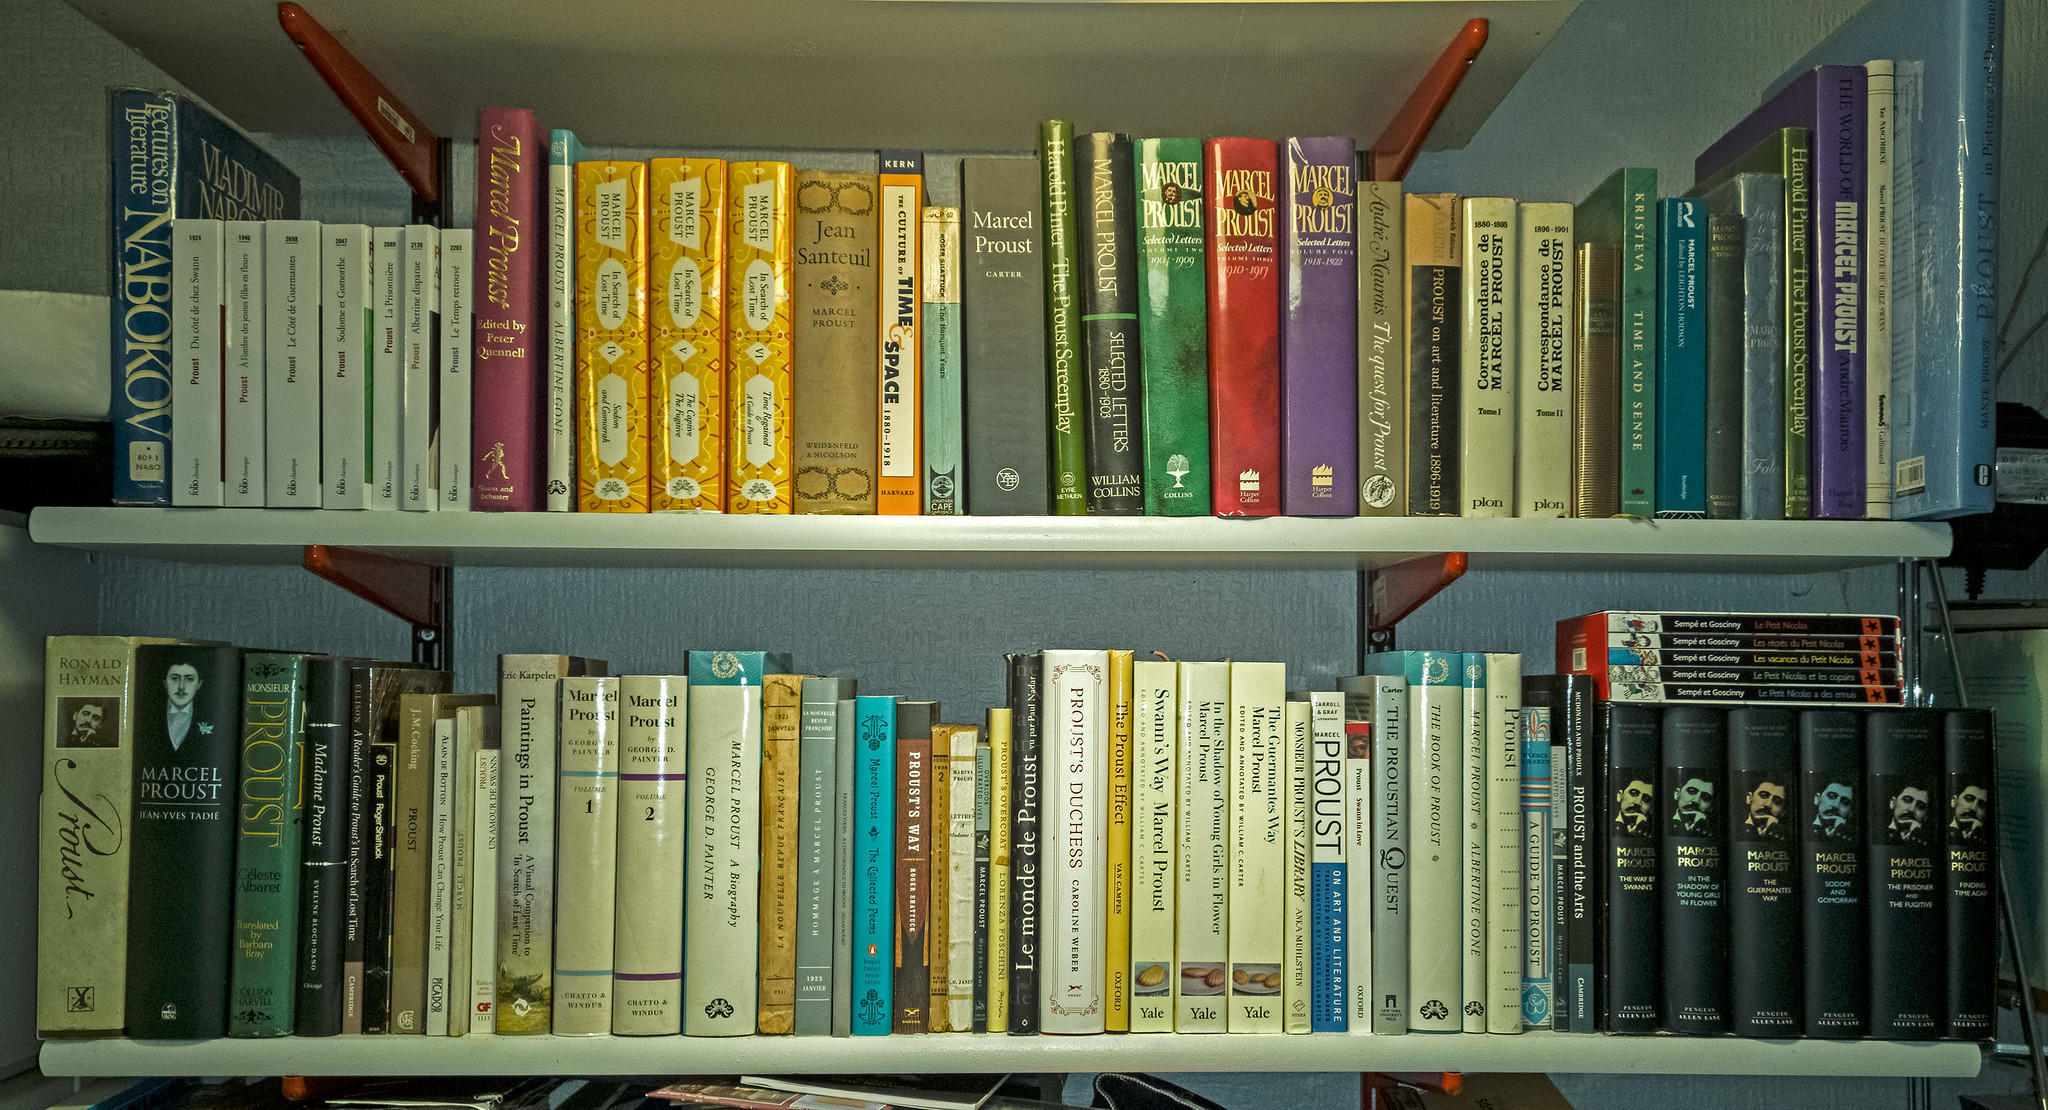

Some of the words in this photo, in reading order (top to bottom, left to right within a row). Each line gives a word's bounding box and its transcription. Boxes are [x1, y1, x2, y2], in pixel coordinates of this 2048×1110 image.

[125, 107, 148, 195] Literature
[145, 103, 171, 176] Lectures
[489, 125, 521, 225] Marcel
[884, 160, 915, 168] KERN
[1046, 138, 1067, 197] Harold
[1140, 161, 1202, 194] MARCEL
[1293, 164, 1354, 197] MARCEL
[152, 179, 169, 206] on
[1092, 159, 1115, 229] MARCEL
[1215, 169, 1275, 202] MARCEL
[600, 193, 610, 240] PROUST
[611, 193, 621, 240] MARCEL
[972, 210, 1033, 230] Marcel
[1049, 198, 1067, 248] Pinter
[1141, 198, 1203, 229] PROUST
[1215, 206, 1276, 238] PROUST
[1292, 203, 1354, 235] PROUST
[814, 219, 856, 244] Jean
[898, 210, 907, 264] CULTURE
[975, 235, 1033, 255] Proust
[1477, 234, 1490, 253] de
[1632, 192, 1645, 273] KRISTEVA
[1833, 201, 1859, 278] MARCEL
[190, 256, 200, 282] Swann
[487, 225, 521, 311] Proust
[797, 247, 871, 269] Santeuil
[898, 265, 904, 275] OF
[1096, 231, 1118, 297] PROUST
[1491, 233, 1504, 307] PROUST
[336, 256, 346, 298] Gomorrhe
[600, 274, 610, 291] Lost
[611, 270, 621, 281] In
[1051, 257, 1071, 297] The
[190, 284, 200, 304] chez
[337, 299, 346, 309] et
[600, 293, 610, 316] Time
[611, 282, 621, 308] Search
[898, 276, 913, 327] TIME
[1432, 268, 1445, 323] PROUST
[124, 206, 173, 441] NABOKOV
[190, 306, 200, 318] de
[190, 319, 200, 336] côté
[336, 311, 346, 343] Sodome
[611, 309, 621, 319] of
[1052, 299, 1072, 348] Proust
[1477, 260, 1491, 390] Correspondance
[1833, 281, 1858, 354] PROUST
[190, 338, 200, 349] Du
[1373, 319, 1393, 351] The
[1431, 327, 1441, 342] on
[1632, 310, 1644, 352] TIME
[336, 351, 346, 377] Proust
[1108, 331, 1127, 392] SELECTED
[1431, 345, 1442, 363] art
[1491, 312, 1504, 391] MARCEL
[190, 358, 200, 385] Proust
[884, 340, 899, 405] SPACE
[1367, 351, 1390, 396] quest
[1431, 367, 1442, 388] and
[1632, 360, 1643, 393] AND
[1054, 348, 1075, 435] Screenplay
[1111, 397, 1129, 453] LETTERS
[1366, 397, 1391, 420] for
[1431, 393, 1442, 449] literature
[1366, 413, 1393, 472] Proust
[1631, 402, 1643, 451] SENSE
[1092, 474, 1140, 486] WILLIAM
[1093, 486, 1141, 498] COLLINS
[1428, 453, 1442, 511] 1896-1919
[1472, 497, 1503, 510] plon
[59, 656, 122, 671] RONALD
[1673, 654, 1699, 664] Sempé
[1707, 654, 1741, 664] Goscinny
[1800, 656, 1810, 664] du
[1810, 655, 1828, 664] Petit
[1828, 656, 1855, 665] Nicolas
[59, 672, 123, 687] HAYMAN
[1068, 687, 1085, 773] PROUST'S
[1112, 701, 1128, 729] The
[1151, 688, 1170, 756] Swann's
[1385, 706, 1400, 740] THE
[1430, 704, 1442, 730] THE
[514, 697, 536, 769] Paintings
[1293, 721, 1305, 773] MONSIEUR
[1503, 708, 1520, 770] Proust
[729, 740, 741, 795] MARCEL
[1112, 733, 1128, 780] Proust
[1430, 733, 1442, 772] BOOK
[140, 765, 222, 782] MARCEL
[240, 696, 290, 848] PROUST
[311, 742, 328, 802] Madame
[519, 775, 533, 789] in
[907, 751, 921, 819] PROUST'S
[1149, 758, 1169, 793] Way
[1430, 775, 1442, 790] OF
[140, 783, 222, 801] PROUST
[1016, 754, 1038, 824] Proust
[1112, 783, 1128, 825] Effect
[1314, 740, 1342, 856] PROUST
[1385, 746, 1400, 841] PROUSTIAN
[436, 813, 448, 834] How
[517, 795, 534, 844] Proust
[728, 797, 741, 849] PROUST
[1293, 776, 1306, 838] PROUST'S
[1430, 792, 1442, 847] PROUST
[1573, 786, 1585, 841] PROUST
[311, 804, 328, 847] Proust
[907, 823, 921, 853] WAY
[1068, 782, 1085, 869] DUCHESS
[1151, 801, 1168, 854] Marcel
[1529, 821, 1540, 831] A
[436, 835, 447, 861] Proust
[1016, 831, 1037, 856] de
[1529, 834, 1540, 874] GUIDE
[1573, 845, 1585, 869] and
[1678, 845, 1720, 857] MARCEL
[1748, 850, 1788, 861] MARCEL
[435, 863, 446, 878] Can
[728, 859, 740, 869] A
[1293, 839, 1306, 903] LIBRARY
[1332, 871, 1343, 885] ON
[1678, 857, 1720, 868] PROUST
[1748, 861, 1790, 872] PROUST
[432, 880, 446, 912] Change
[1151, 859, 1168, 912] Proust
[1380, 846, 1406, 914] QUEST
[1529, 879, 1540, 896] TO
[1573, 871, 1585, 890] the
[725, 871, 741, 929] Biography
[1015, 864, 1036, 937] monde
[1071, 879, 1080, 933] CAROLINE
[1332, 890, 1343, 914] ART
[1573, 893, 1585, 919] Arts
[433, 914, 445, 934] Your
[1332, 919, 1343, 943] AND
[1529, 899, 1541, 966] PROUST
[432, 934, 444, 951] Life
[1014, 943, 1036, 972] Le
[1071, 936, 1080, 973] WEBER
[430, 977, 443, 1013] PICADOR
[1331, 947, 1342, 1022] LITERATURE
[1140, 1007, 1165, 1019] Yale
[1190, 1008, 1217, 1020] Yale
[1243, 1006, 1270, 1019] Yale
